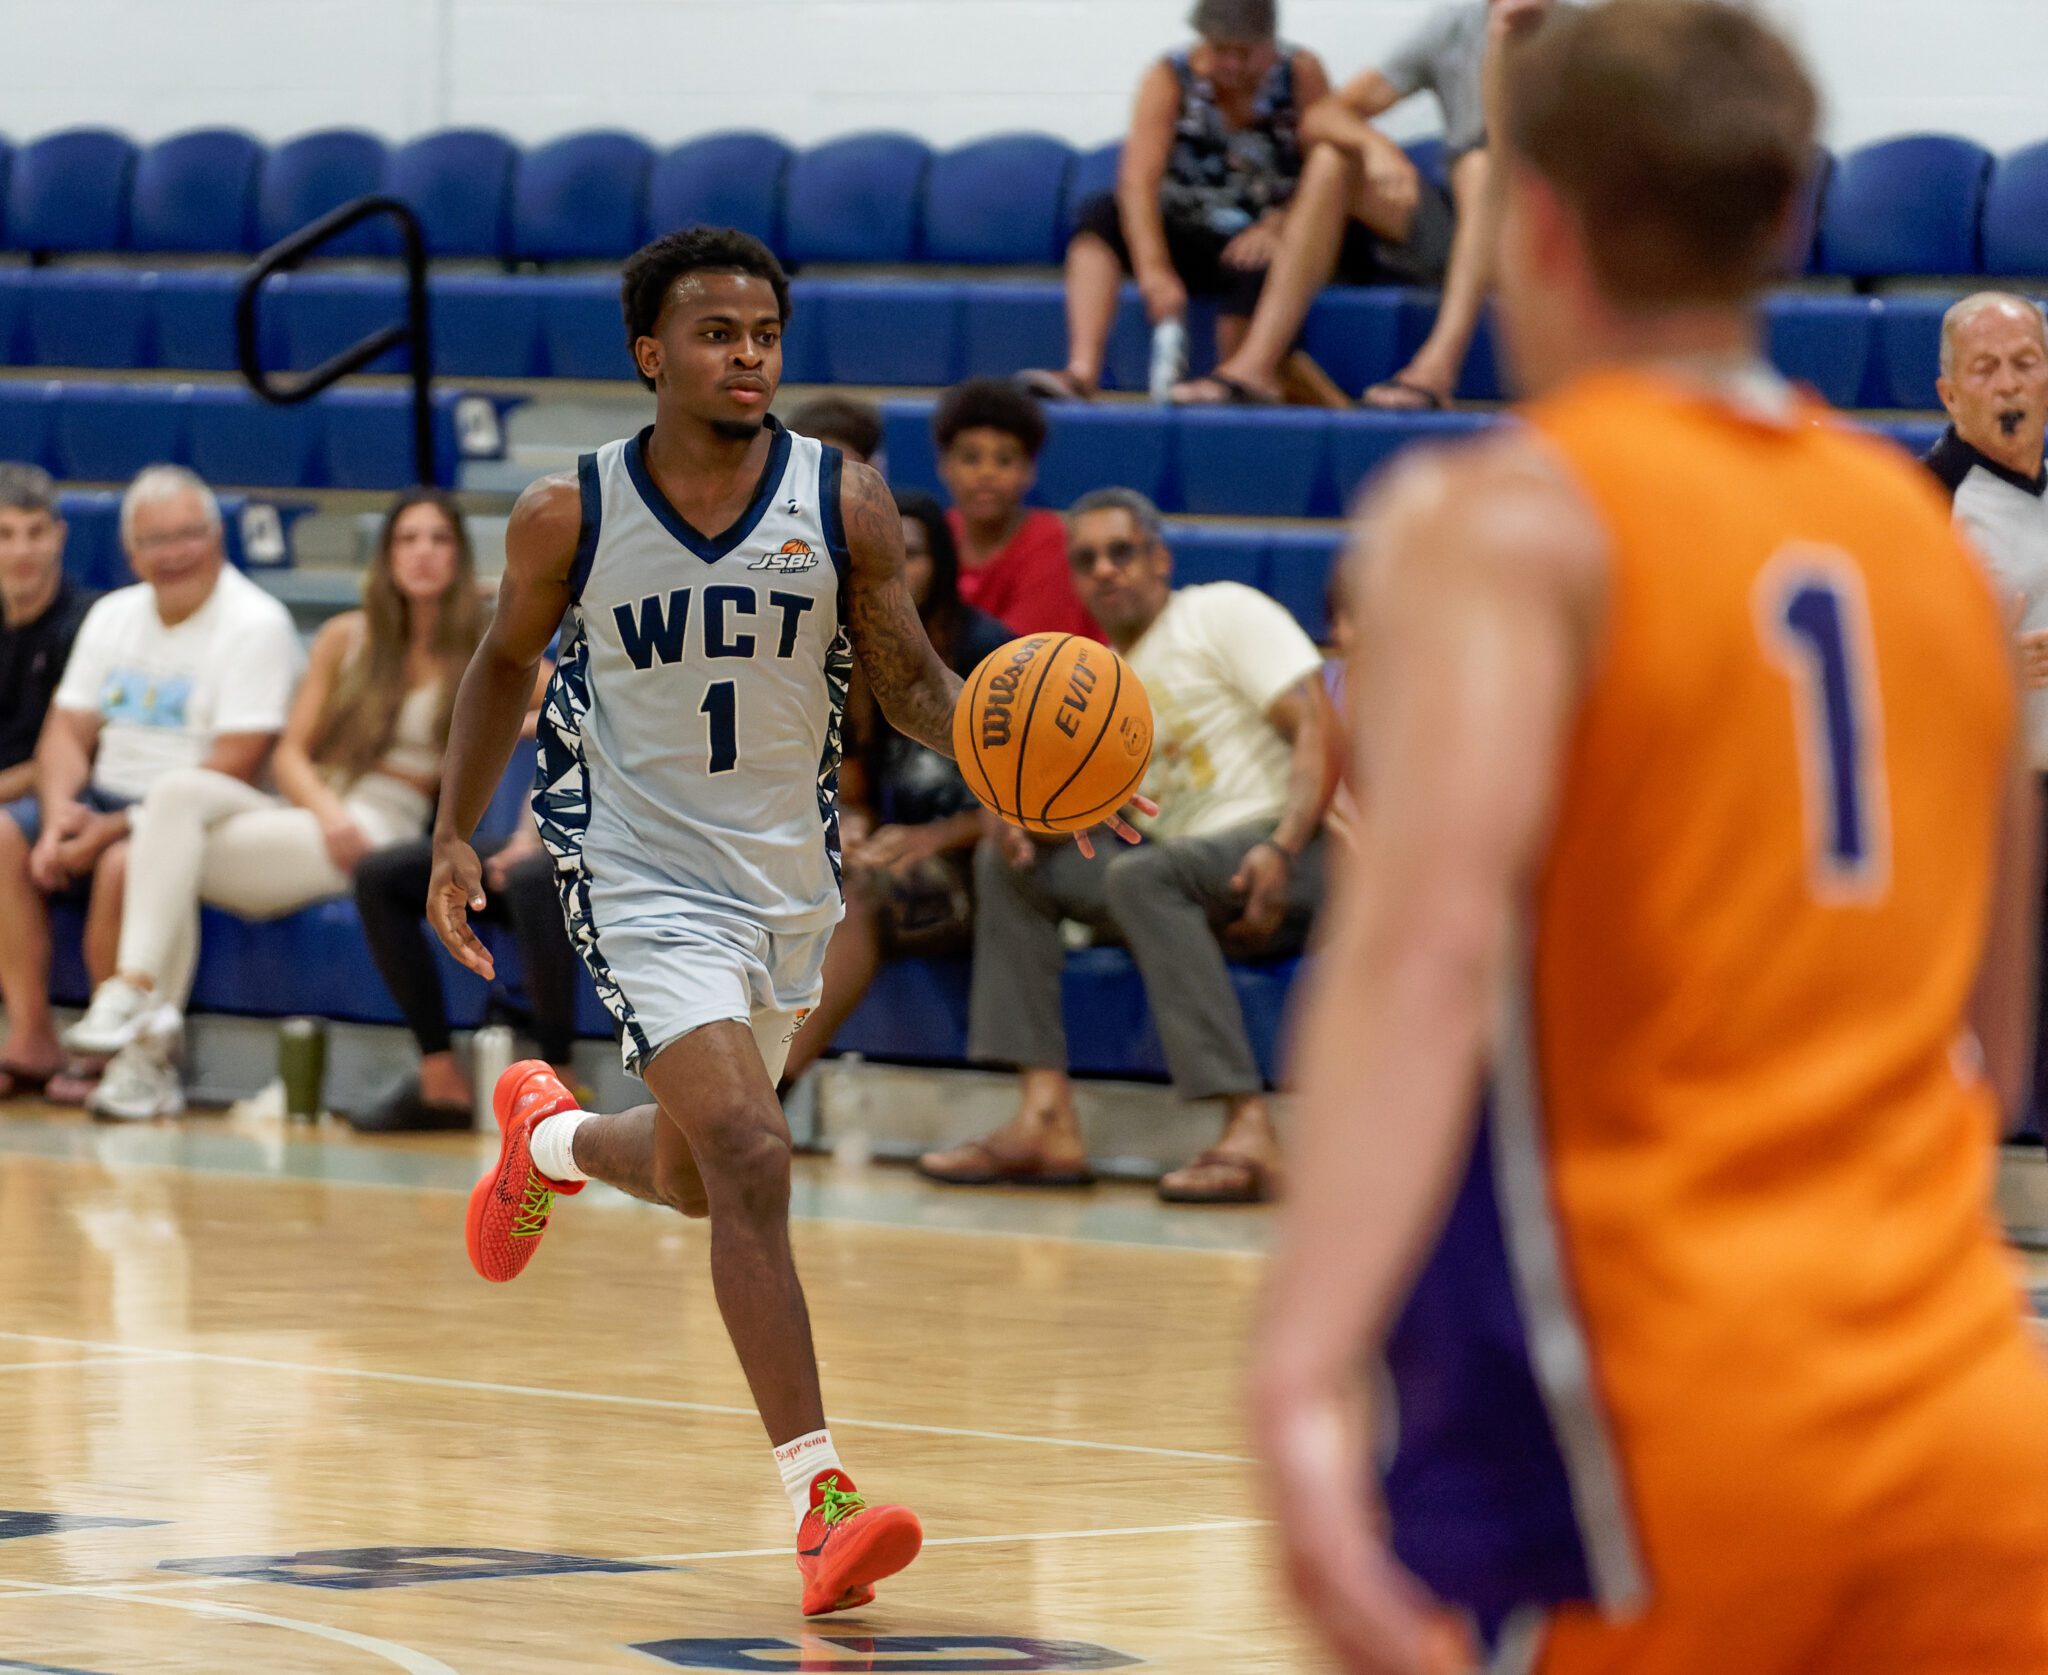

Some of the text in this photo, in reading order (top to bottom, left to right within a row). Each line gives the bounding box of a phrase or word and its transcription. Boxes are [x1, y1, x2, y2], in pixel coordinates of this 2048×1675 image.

[747, 551, 819, 570] JSBL
[611, 583, 816, 671] WCT
[697, 677, 741, 778] 1
[1055, 663, 1097, 738] EVO
[1764, 556, 1882, 890] 1
